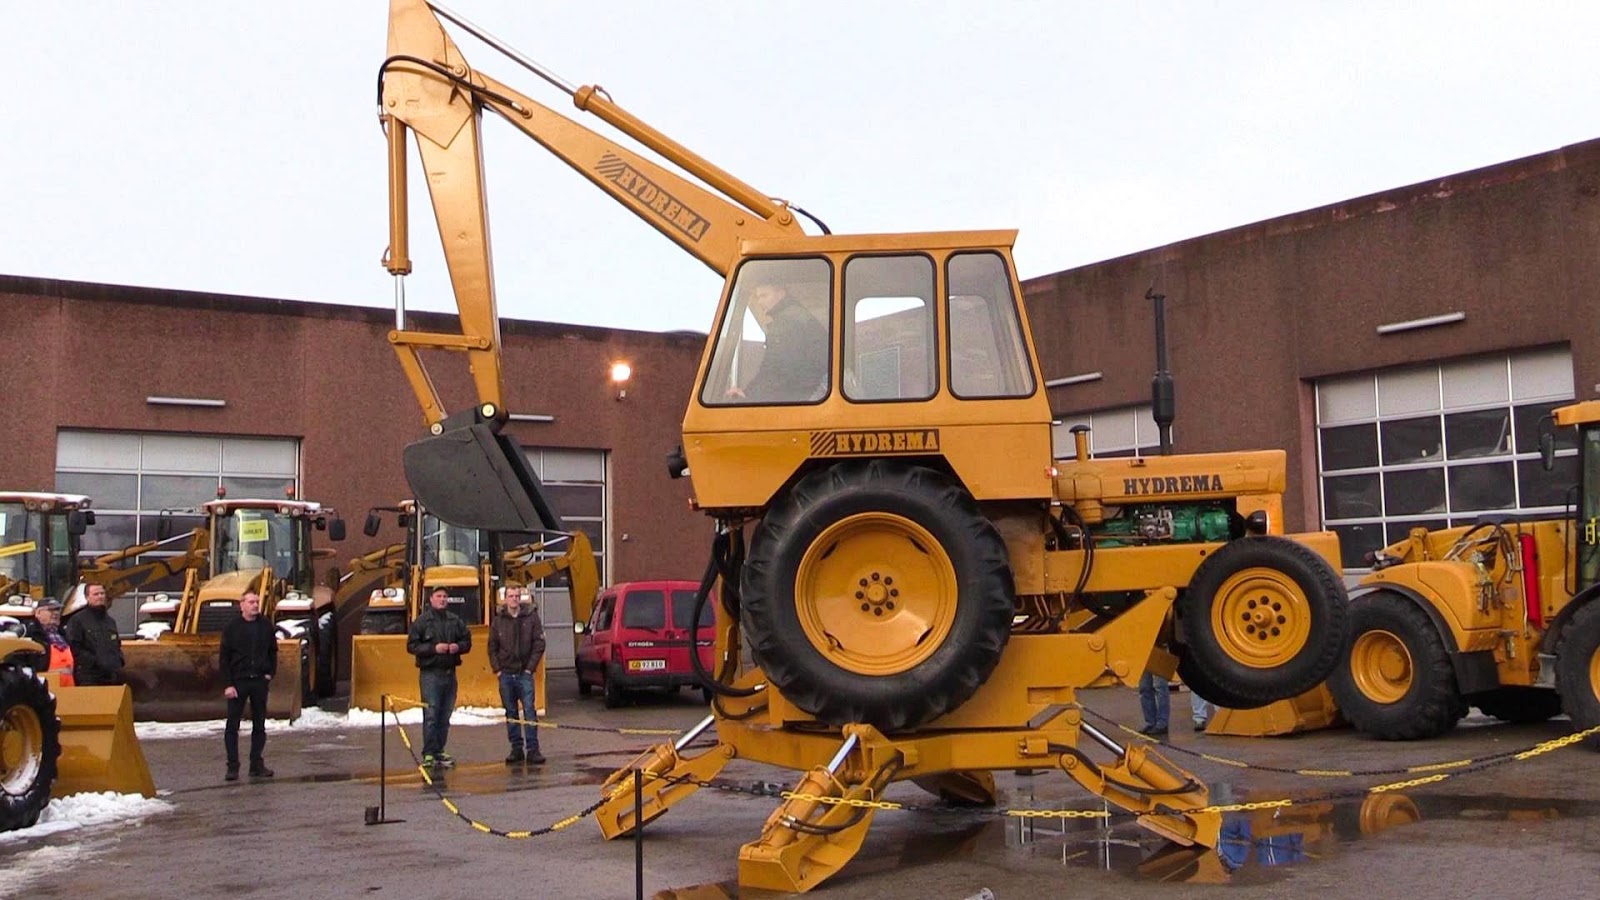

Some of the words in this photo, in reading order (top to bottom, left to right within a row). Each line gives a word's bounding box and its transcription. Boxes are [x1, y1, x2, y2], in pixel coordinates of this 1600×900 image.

[615, 164, 707, 241] HYDREMA
[835, 431, 938, 452] HYDREMA
[1123, 474, 1223, 495] HYDREMA
